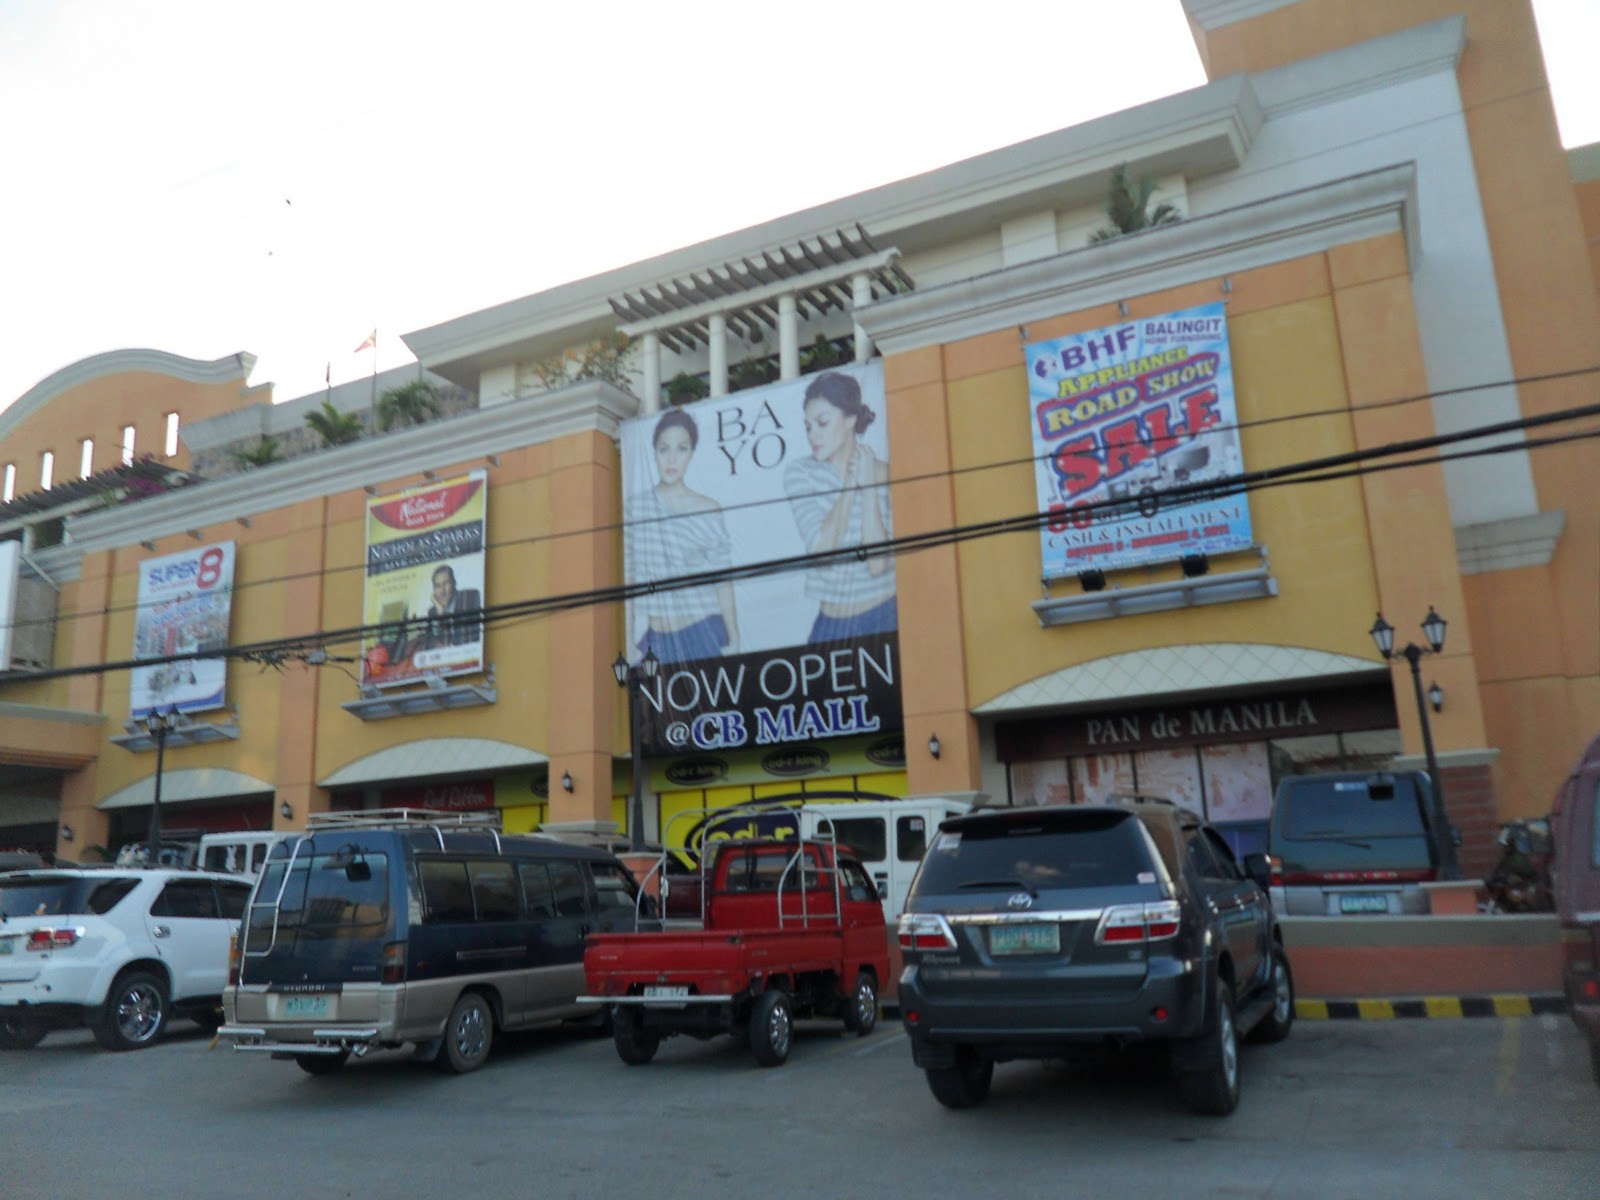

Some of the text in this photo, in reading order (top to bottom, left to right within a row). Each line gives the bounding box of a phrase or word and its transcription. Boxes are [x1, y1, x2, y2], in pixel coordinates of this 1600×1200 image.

[1061, 325, 1137, 370] BHF
[1145, 319, 1221, 335] BALINGIT
[1046, 357, 1216, 432] ROAD SHOW
[1057, 345, 1188, 399] APPLIANCE
[719, 432, 786, 475] YO
[1055, 386, 1221, 498] SALE
[432, 525, 480, 548] SPARKS
[1049, 527, 1093, 549] CASH
[1098, 528, 1109, 541] &
[1116, 506, 1241, 538] INSTALLMENT
[148, 559, 198, 585] SUPER
[197, 547, 224, 589] 8
[639, 643, 894, 713] NOW OPEN
[754, 695, 880, 744] MALL
[1086, 700, 1318, 746] PAN de MANILA
